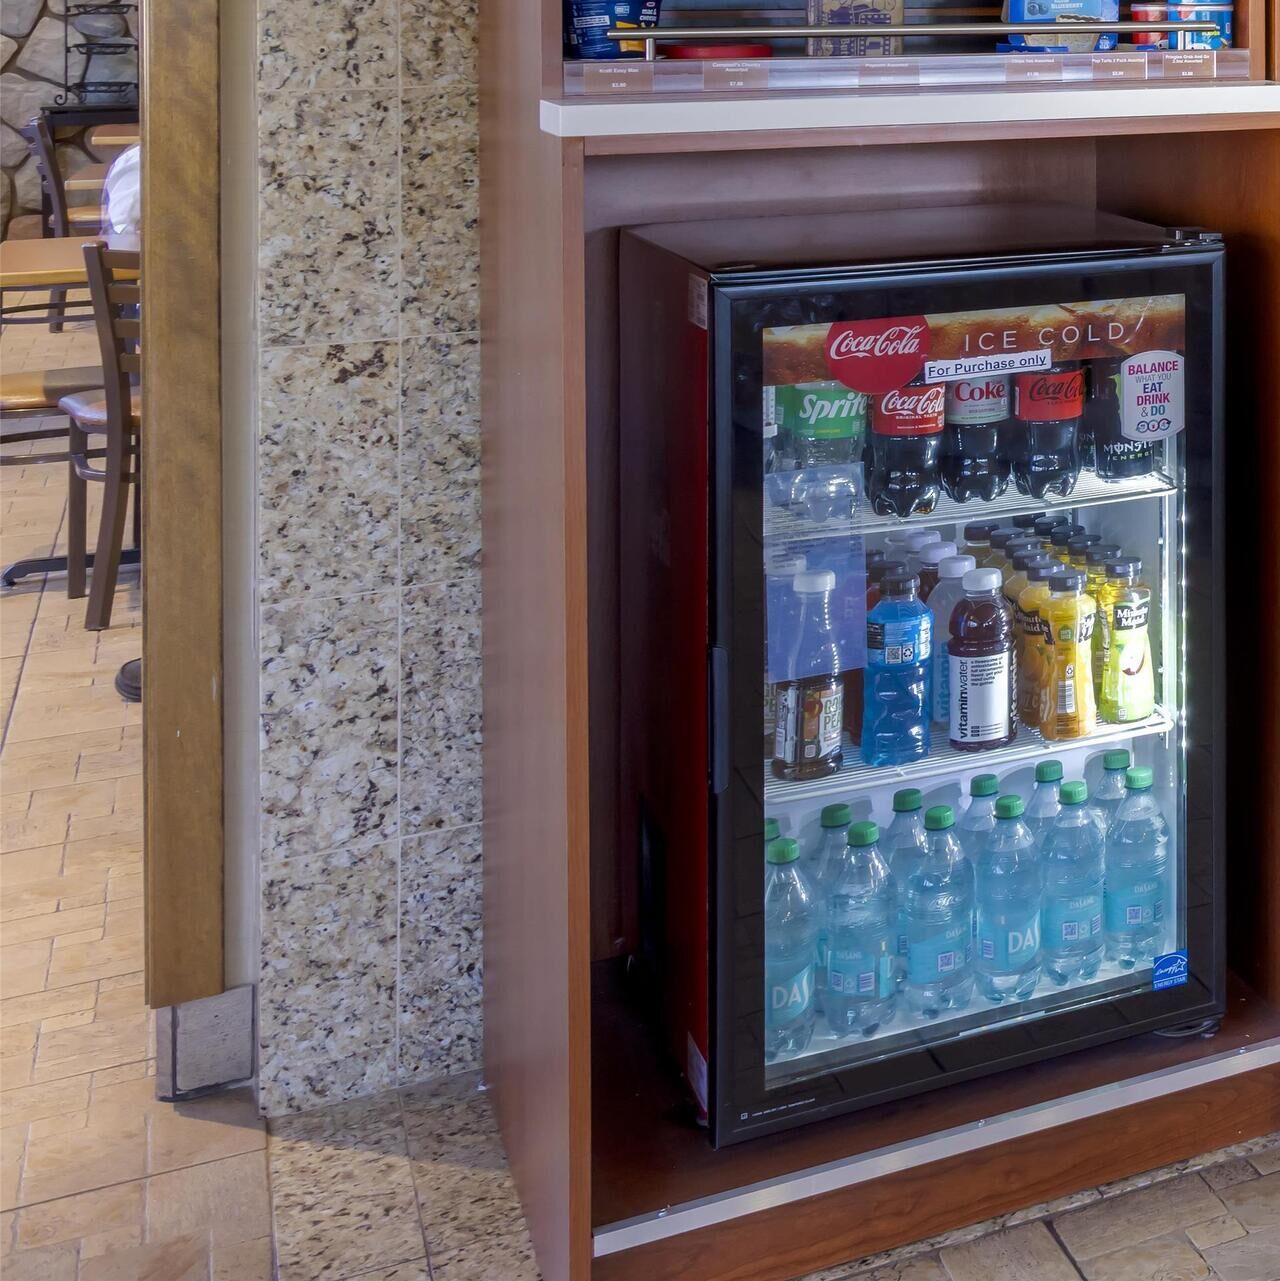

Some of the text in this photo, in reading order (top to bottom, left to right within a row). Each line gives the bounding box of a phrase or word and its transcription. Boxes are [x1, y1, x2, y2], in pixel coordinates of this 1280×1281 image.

[1051, 1, 1084, 9] BLUEBERRY
[829, 325, 927, 360] Coca-Cola
[963, 322, 1125, 352] ICE COLD
[928, 354, 1047, 377] For Purchase only
[1127, 360, 1180, 377] BALANCE
[1134, 372, 1172, 383] WHAT YOU
[954, 381, 1005, 403] Coke
[1143, 382, 1163, 394] EAT
[1136, 393, 1171, 406] DRINK
[1140, 404, 1167, 417] & DO
[1116, 605, 1149, 619] Minute
[958, 659, 968, 739] vitaminwater
